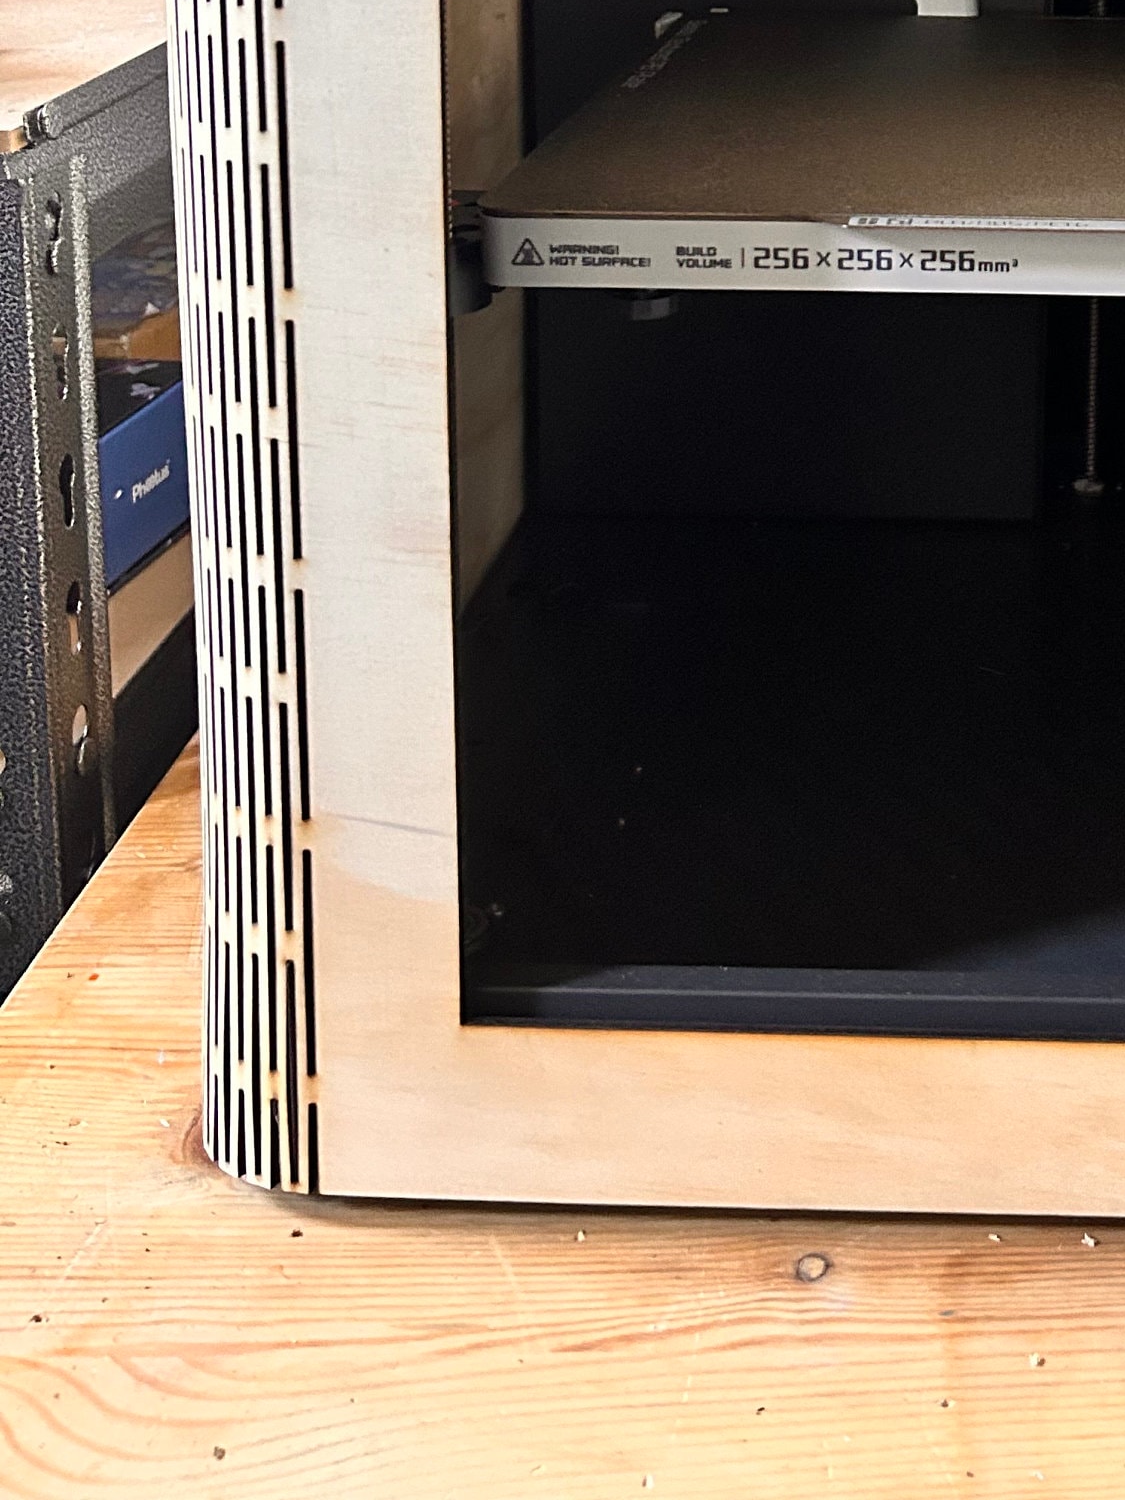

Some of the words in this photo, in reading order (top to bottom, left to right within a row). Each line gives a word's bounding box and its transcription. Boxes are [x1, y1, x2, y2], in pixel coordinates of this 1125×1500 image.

[549, 244, 619, 256] WARNING!
[676, 246, 717, 257] BUILD
[549, 256, 580, 267] HOT
[582, 257, 651, 268] SURFACE!
[676, 258, 732, 269] VOLUME
